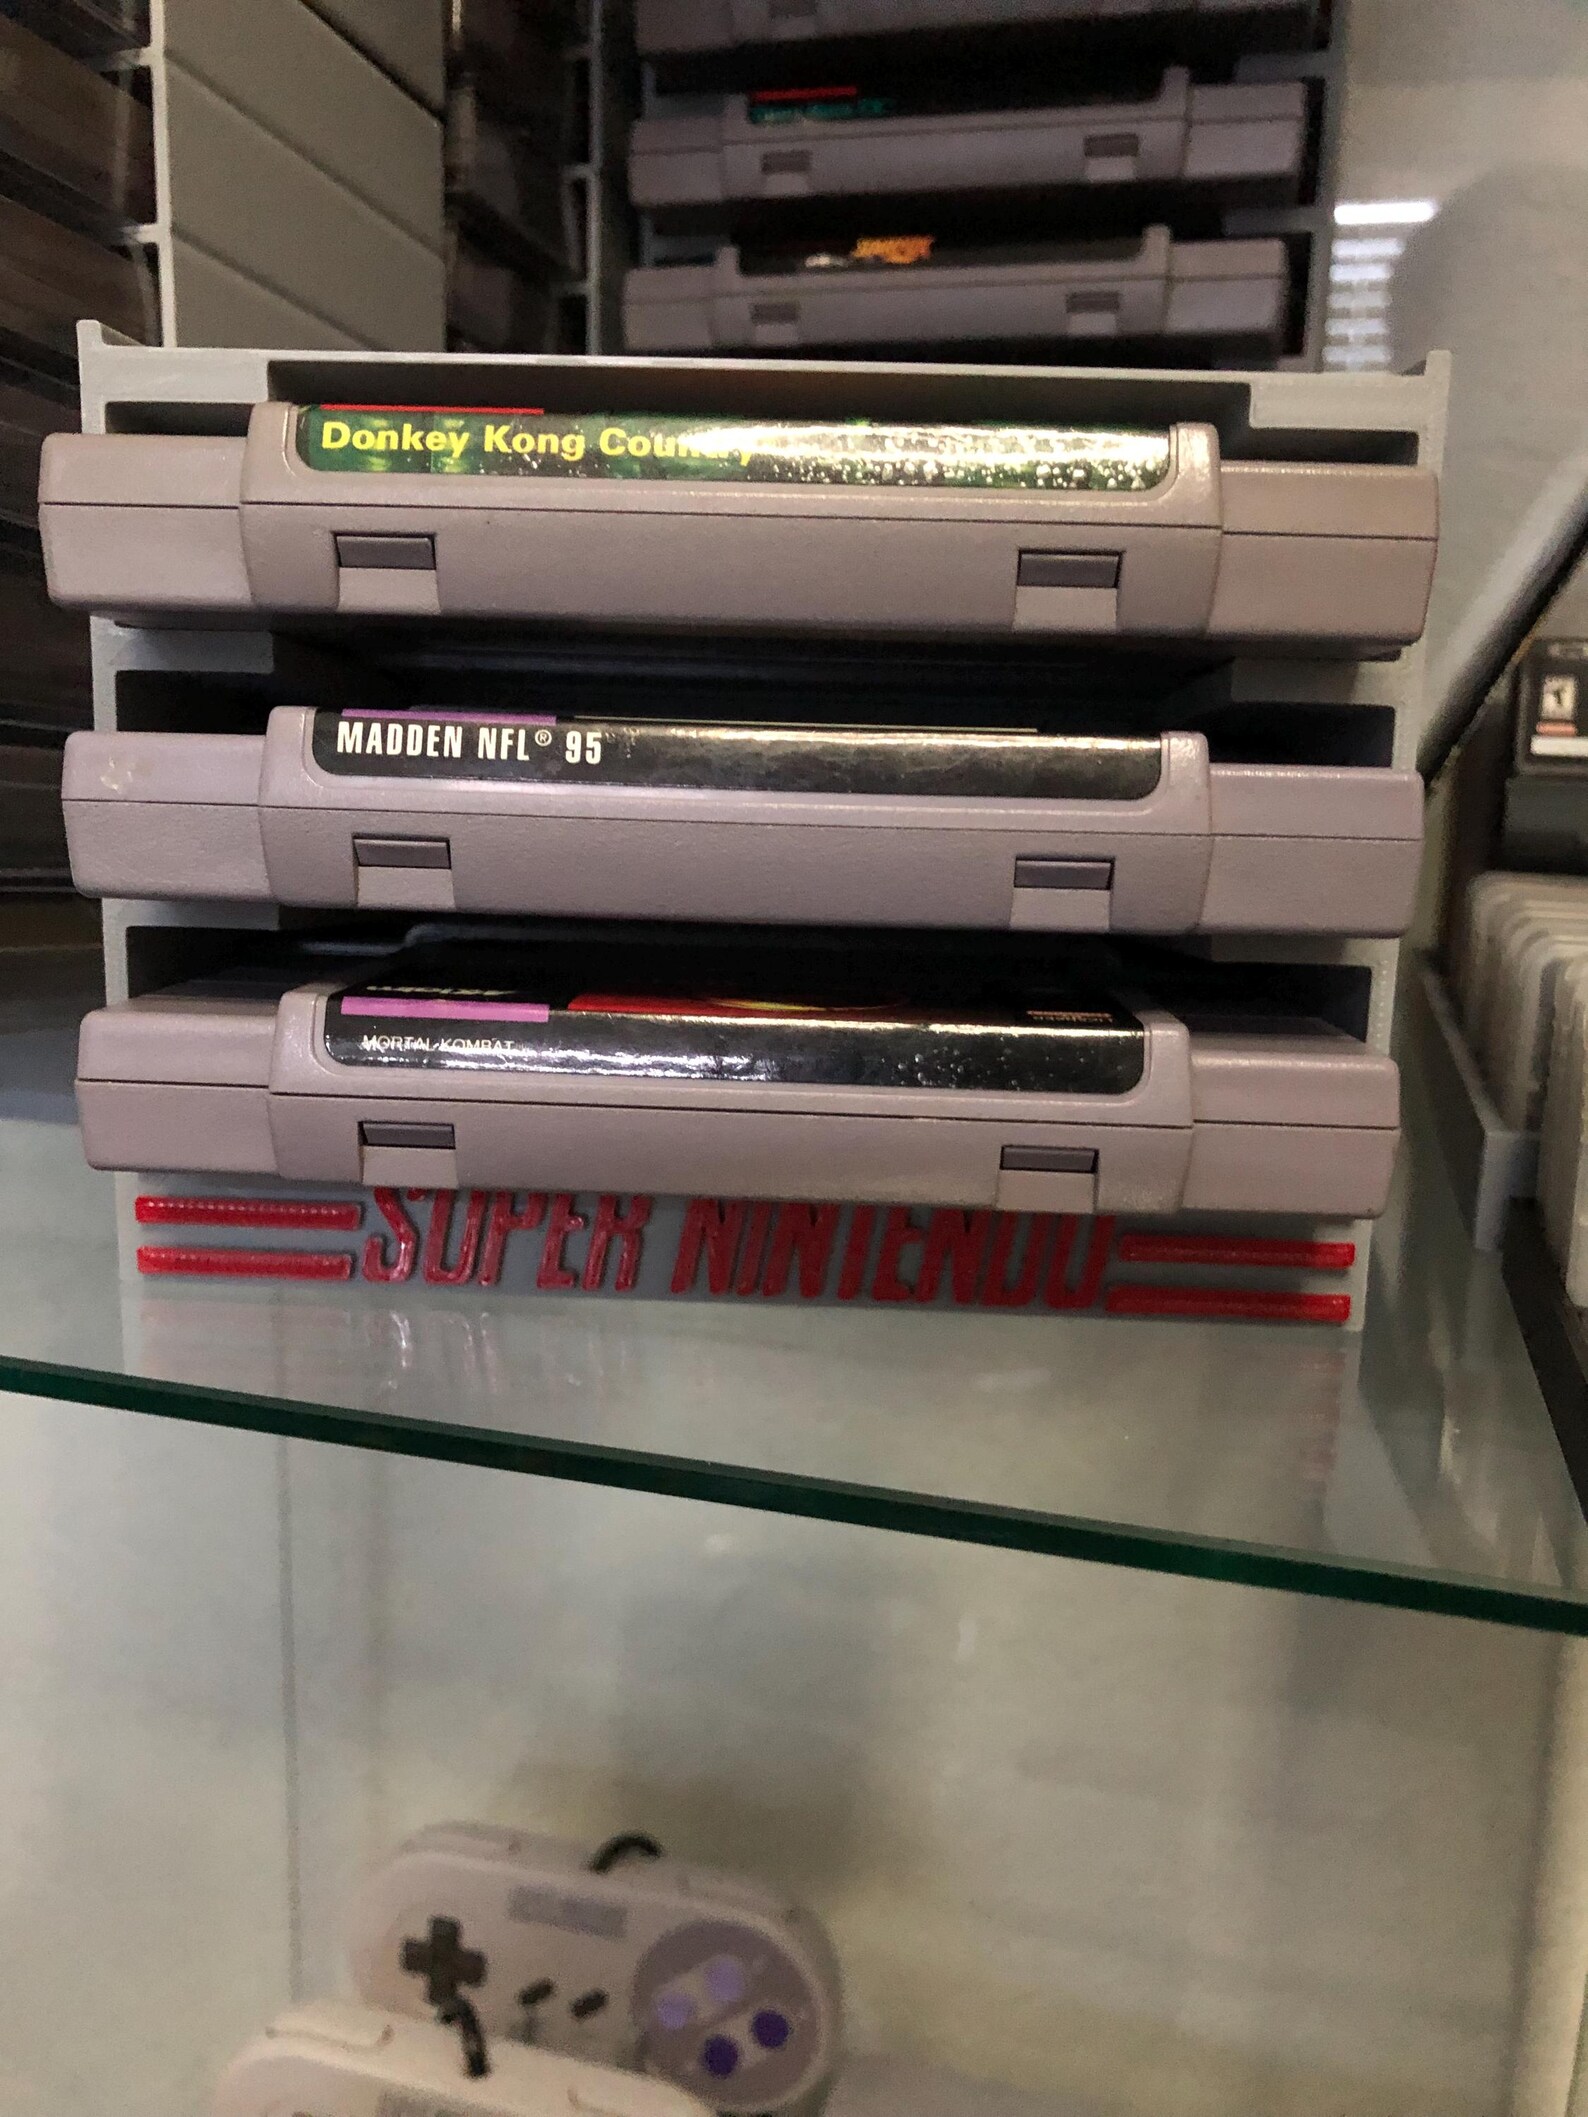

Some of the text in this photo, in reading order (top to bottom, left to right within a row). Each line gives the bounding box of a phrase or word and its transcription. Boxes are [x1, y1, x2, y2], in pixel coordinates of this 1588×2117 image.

[321, 420, 752, 467] Donkey Kong Couy
[337, 721, 463, 758] MADDEN
[565, 730, 602, 765] 95
[361, 1034, 516, 1052] MORTAL KOMBAT
[362, 1186, 651, 1293] SUPER
